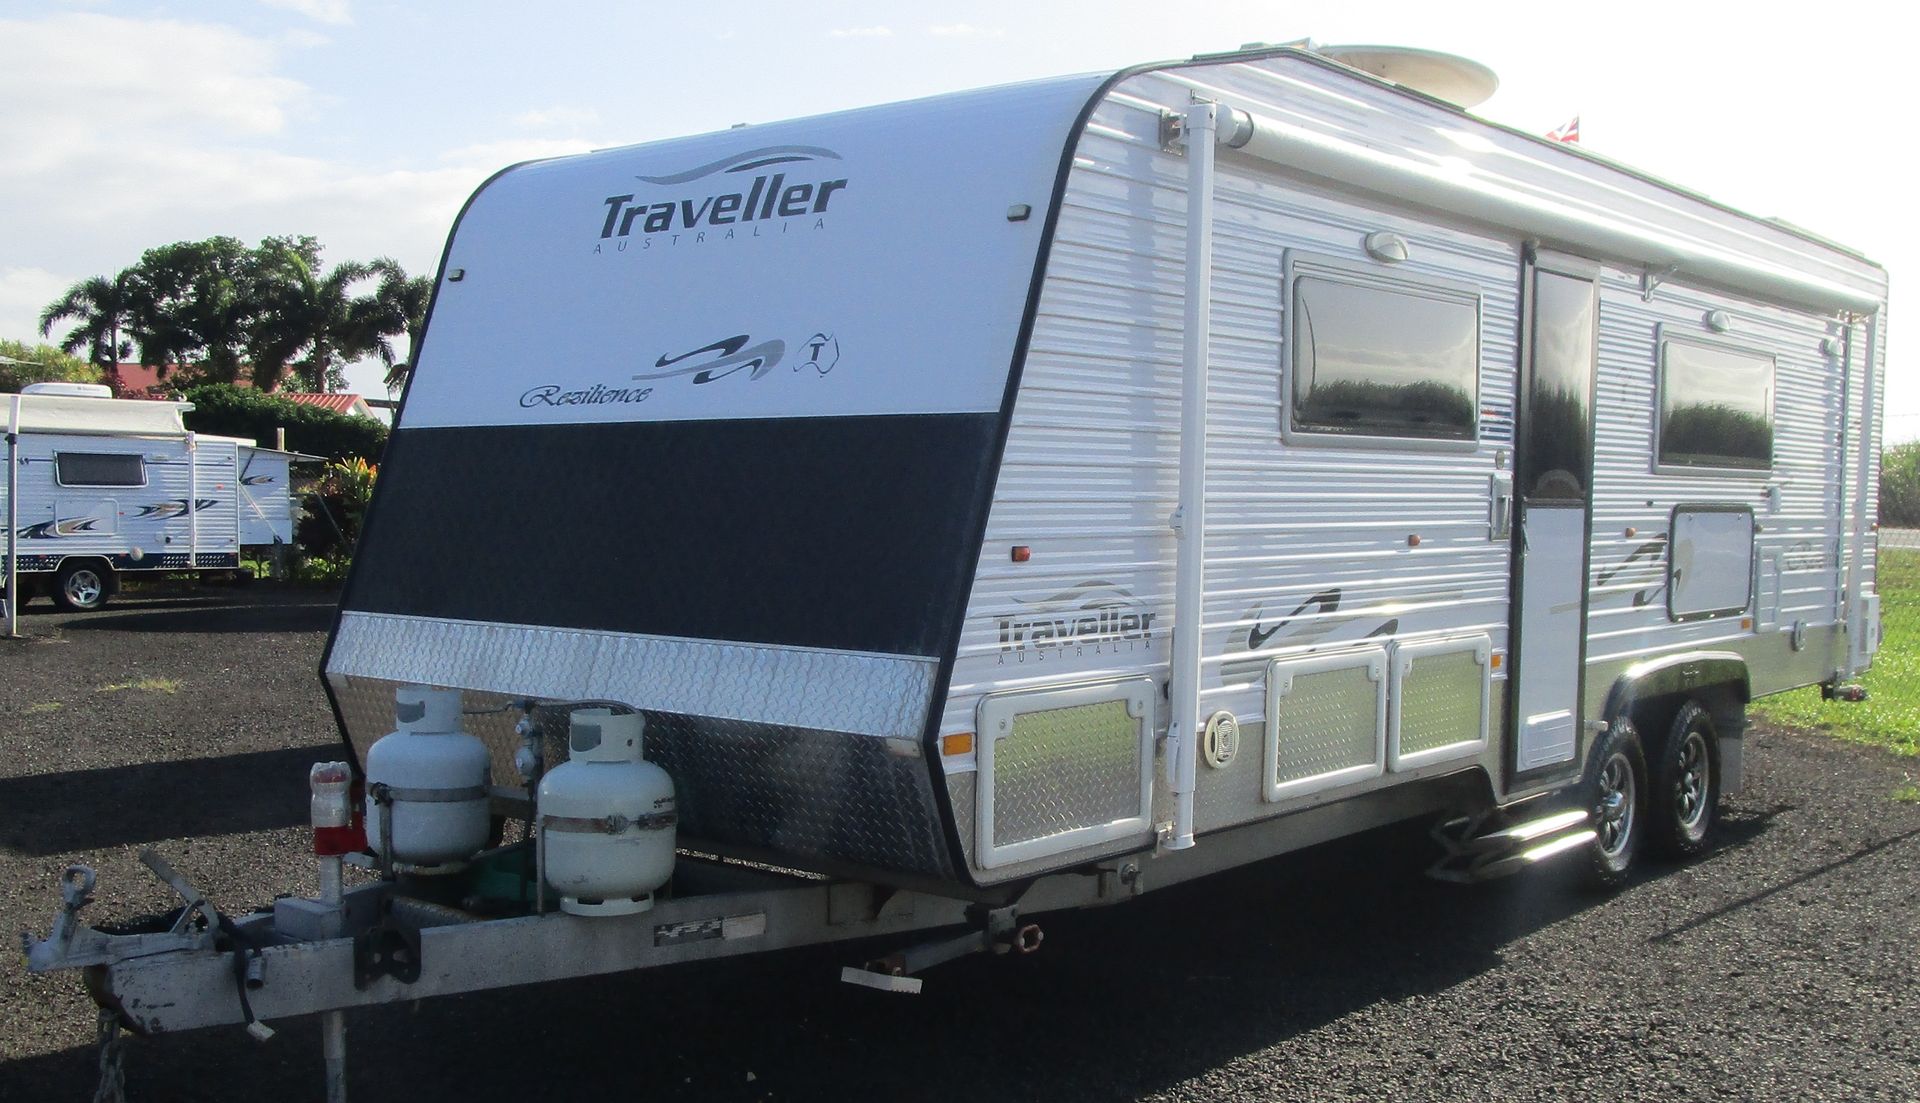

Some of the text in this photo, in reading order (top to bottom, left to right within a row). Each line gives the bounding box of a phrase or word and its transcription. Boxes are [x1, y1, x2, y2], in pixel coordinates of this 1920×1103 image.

[600, 173, 848, 239] Traveller
[593, 217, 825, 255] AUSTRALIA
[519, 383, 653, 408] Rezilience
[993, 606, 1156, 652] Traveller
[998, 640, 1151, 665] AUSTRALIA
